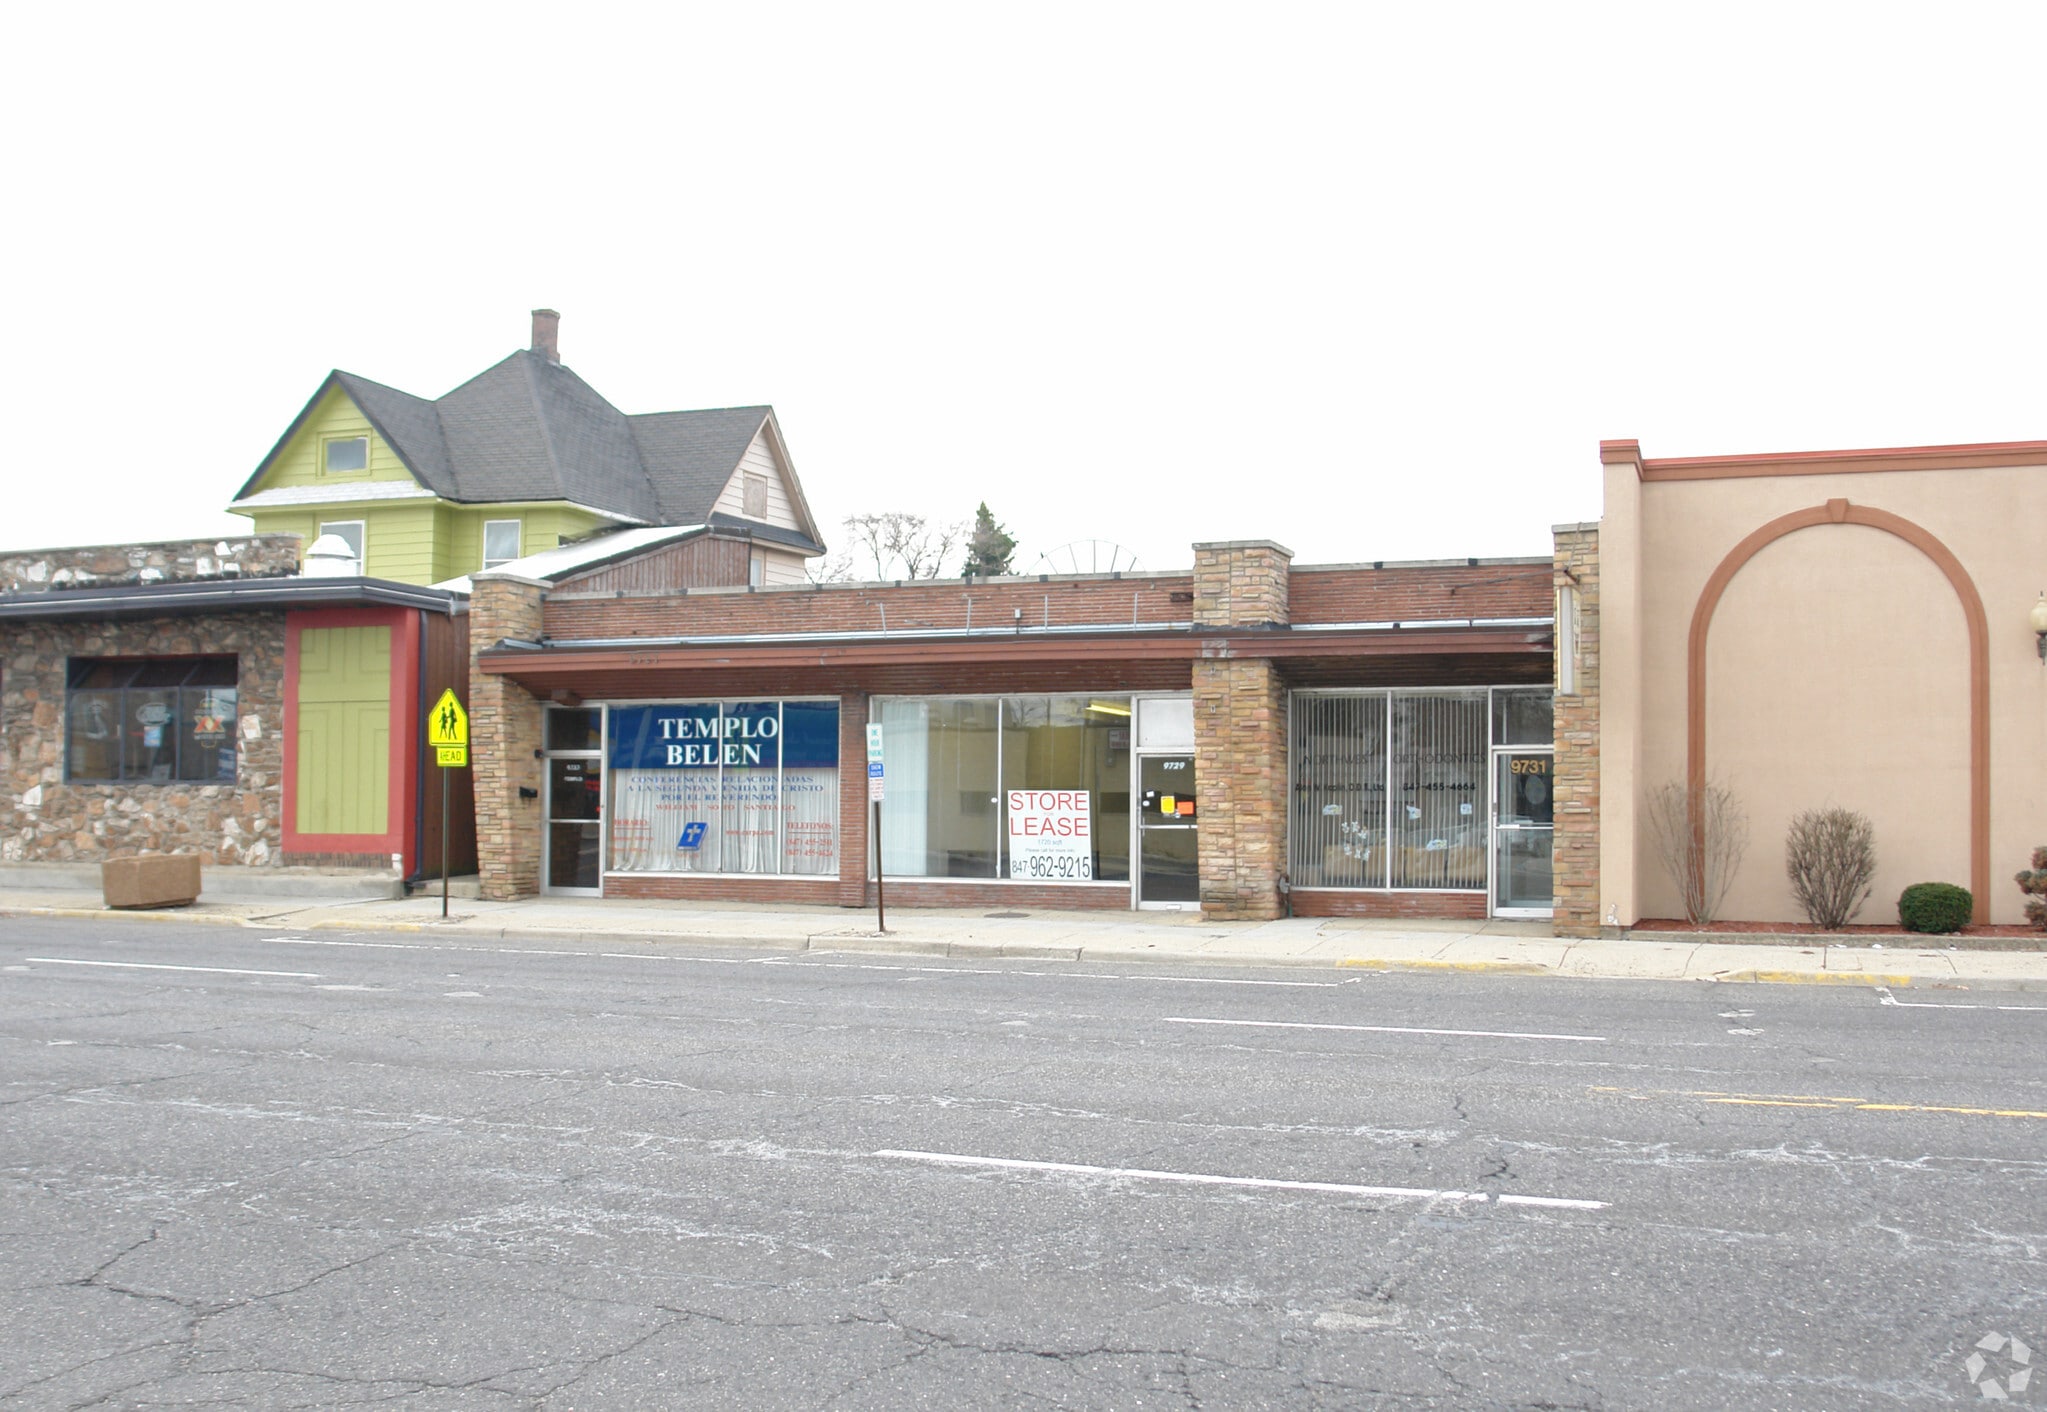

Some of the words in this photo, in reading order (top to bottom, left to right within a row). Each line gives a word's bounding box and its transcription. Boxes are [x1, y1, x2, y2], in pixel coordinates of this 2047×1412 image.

[658, 717, 778, 739] TEMPLO
[440, 750, 462, 761] AHEAD
[665, 744, 763, 765] BELEN
[1392, 753, 1486, 765] ORTHODONTICS
[1163, 761, 1186, 770] 9729
[1510, 759, 1548, 775] 9731
[631, 776, 717, 784] CONFERENCIAS
[1010, 792, 1088, 811] STORE
[1010, 817, 1089, 836] LEASE
